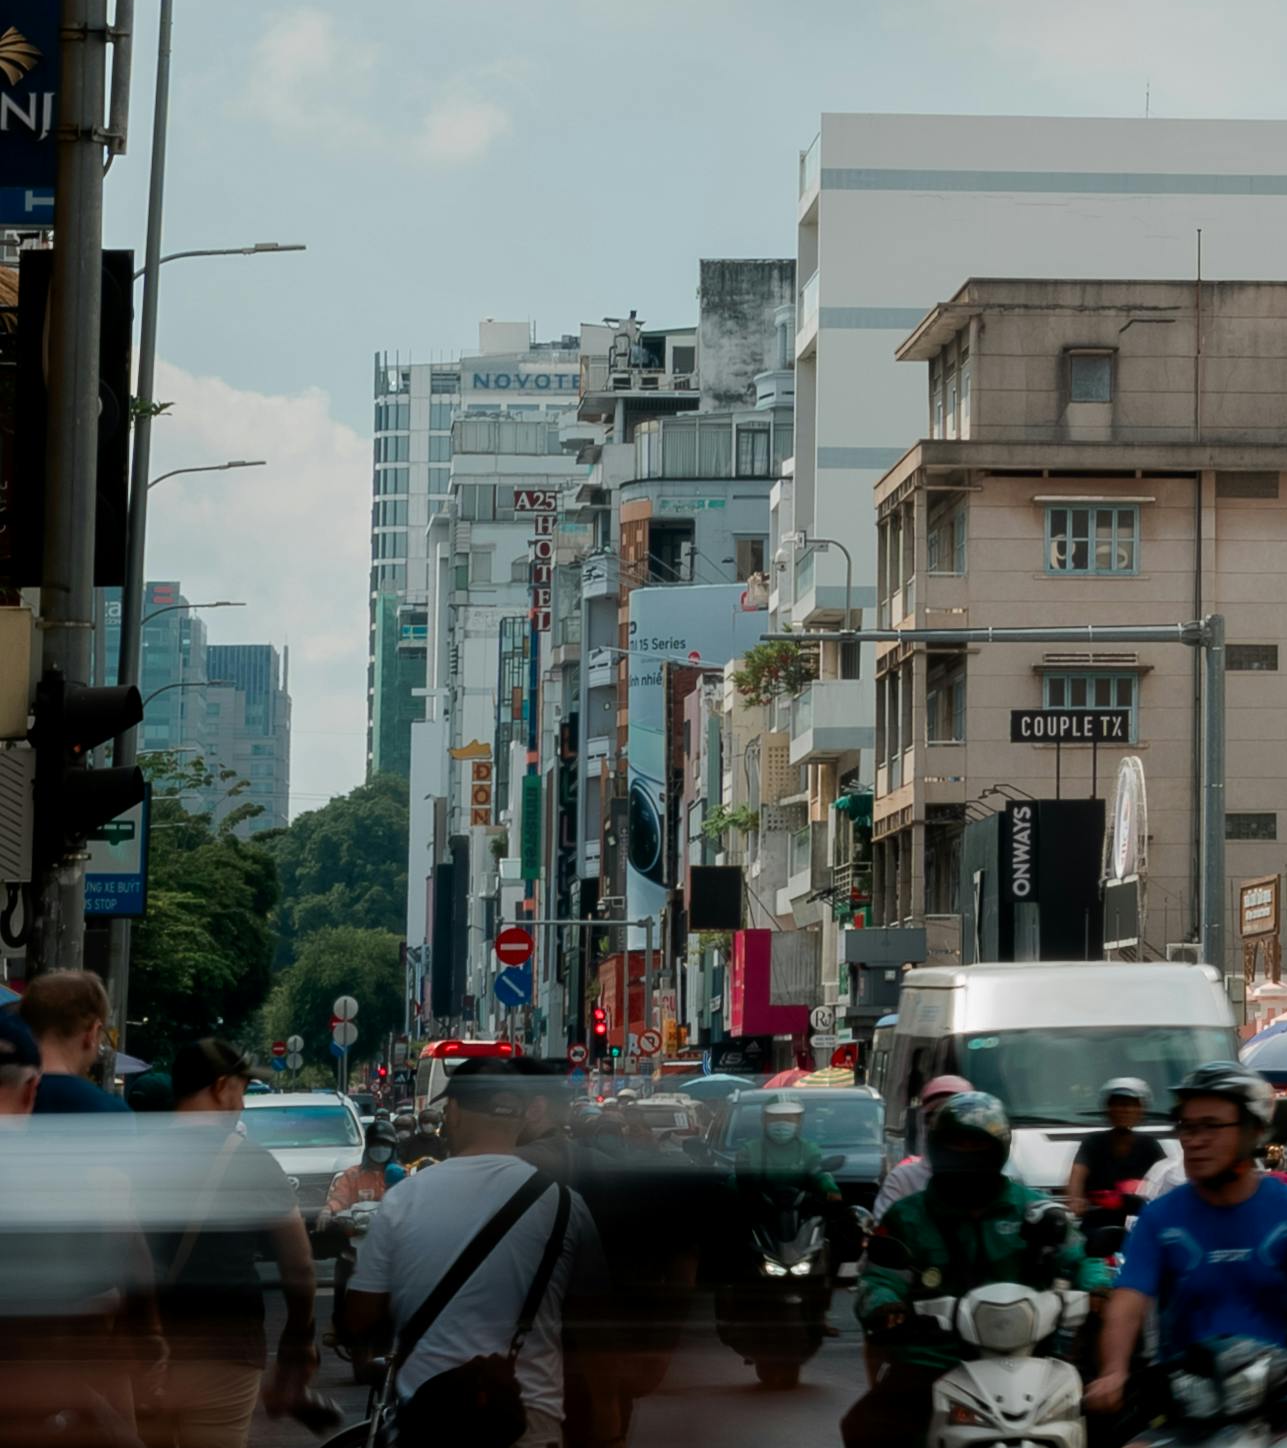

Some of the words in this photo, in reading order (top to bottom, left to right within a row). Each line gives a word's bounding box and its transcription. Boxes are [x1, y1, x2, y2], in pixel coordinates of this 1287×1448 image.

[0, 91, 55, 142] NJ
[473, 373, 580, 390] NOVOTE
[516, 492, 556, 509] A25
[535, 516, 553, 631] HOTEL
[652, 637, 686, 650] Series
[1021, 716, 1093, 737] COUPLE
[1012, 806, 1032, 896] ONWAYS
[94, 898, 118, 910] STOP
